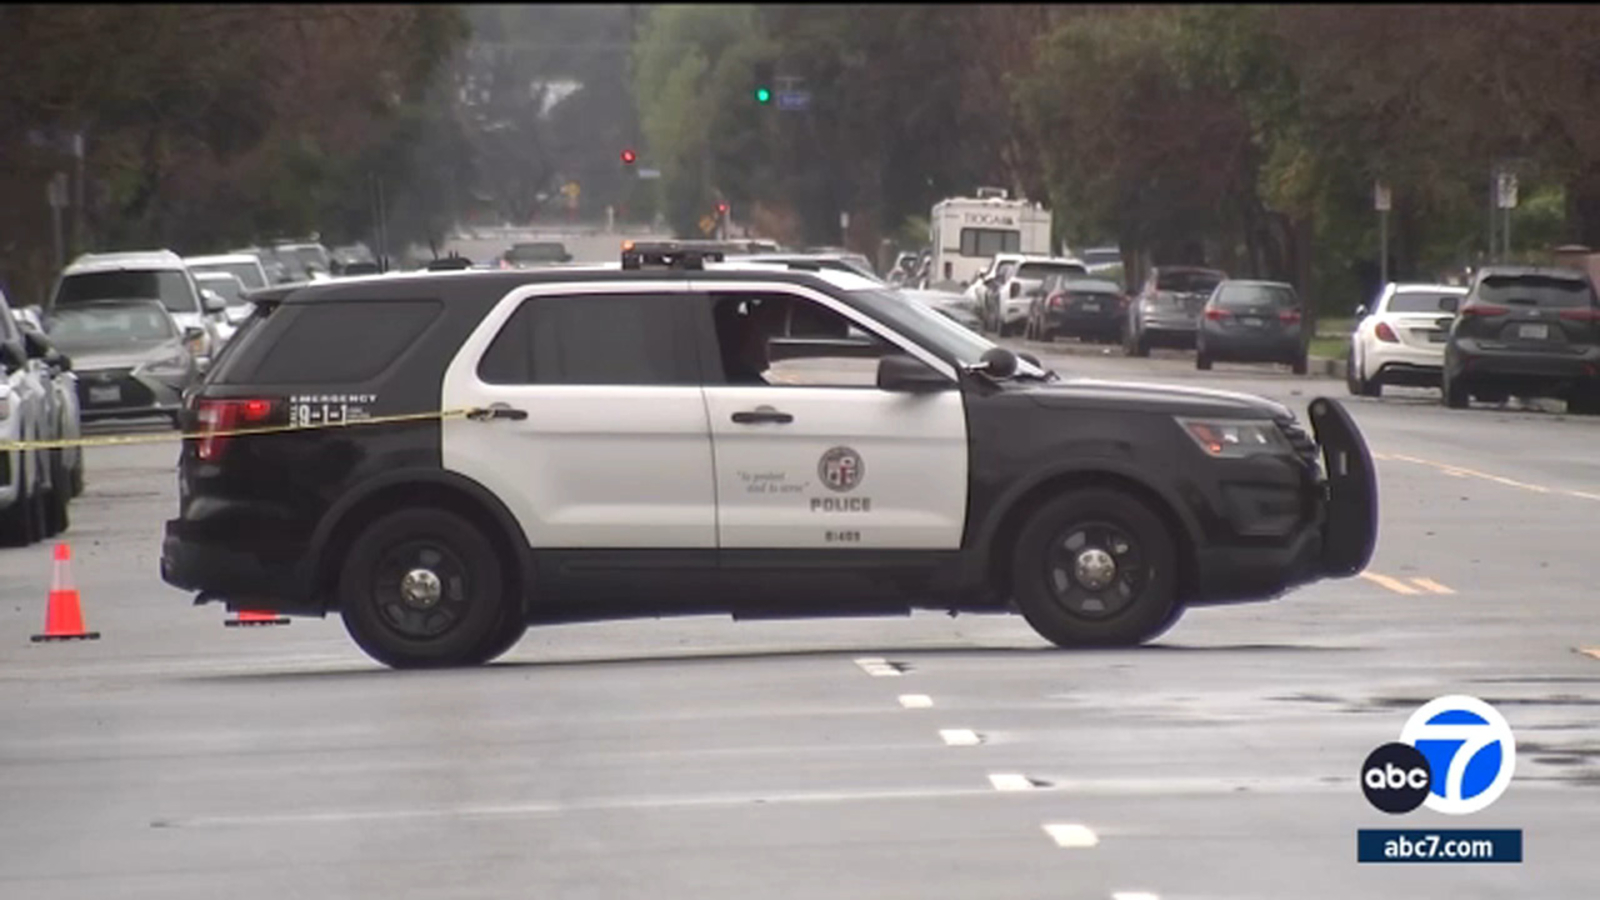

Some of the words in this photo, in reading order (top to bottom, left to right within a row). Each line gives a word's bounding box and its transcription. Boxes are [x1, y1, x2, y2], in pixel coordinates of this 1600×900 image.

[290, 395, 377, 403] EMERGENCY
[299, 404, 347, 427] 9-1-1
[810, 498, 871, 512] POLICE
